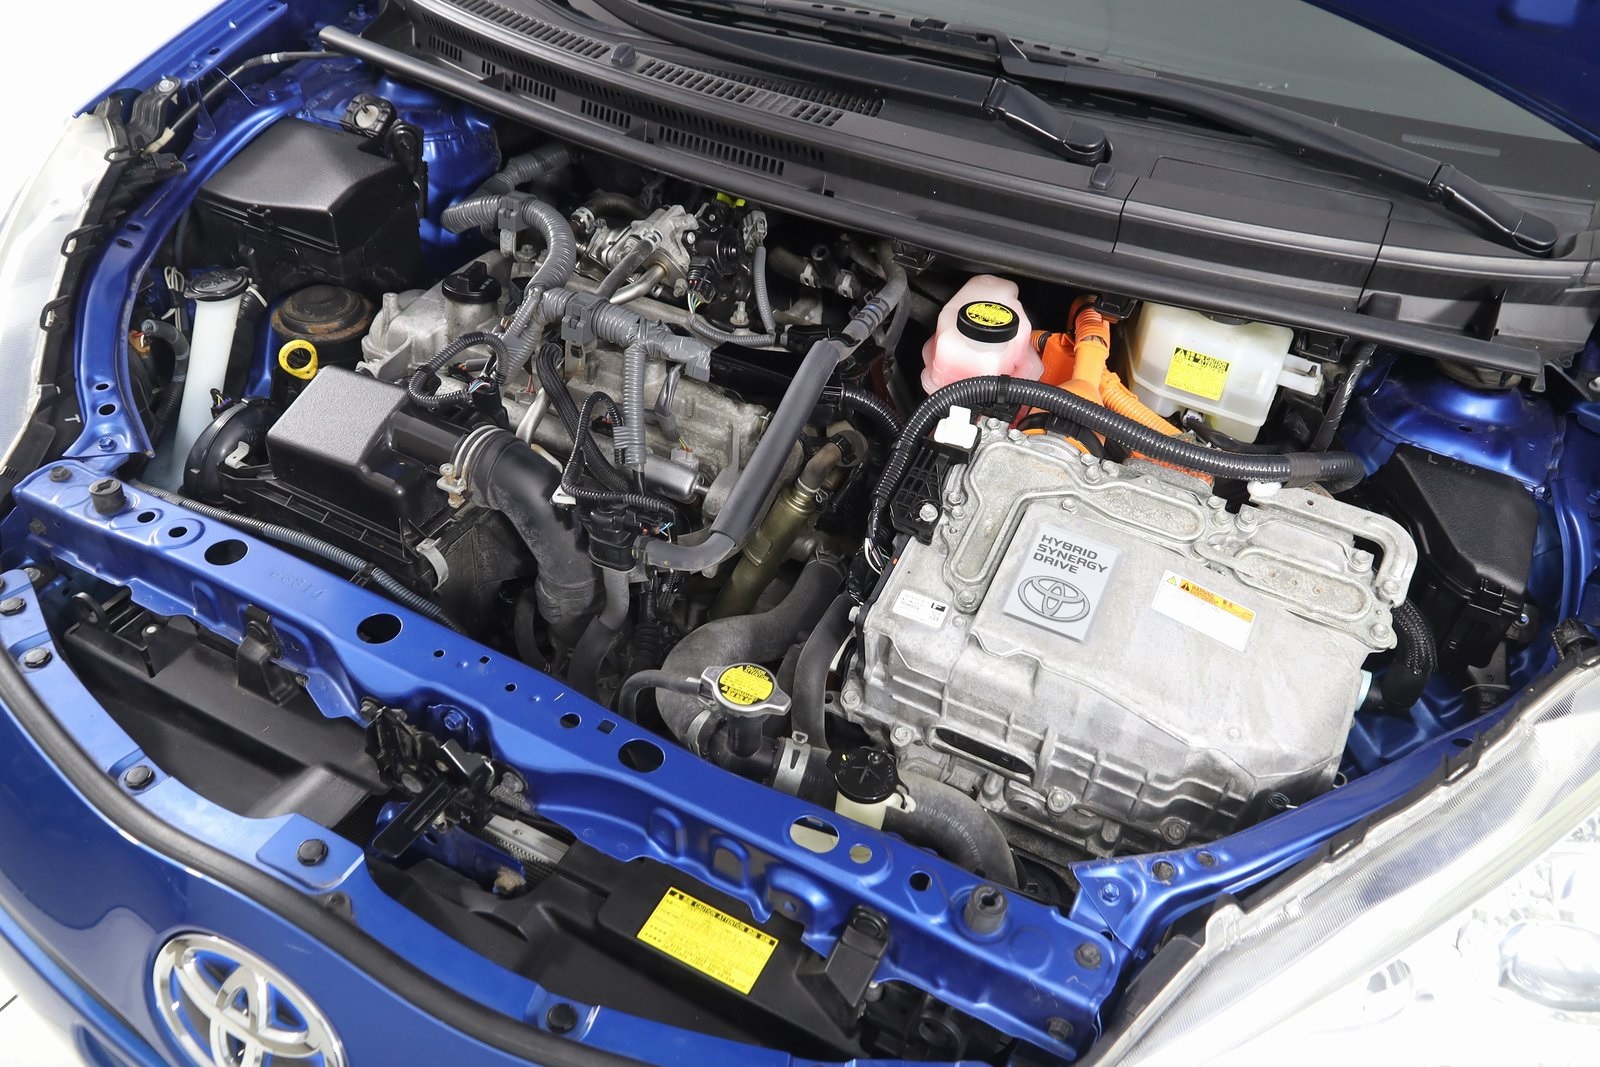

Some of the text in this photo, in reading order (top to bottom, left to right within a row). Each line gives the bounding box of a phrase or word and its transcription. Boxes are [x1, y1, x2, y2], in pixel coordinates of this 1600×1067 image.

[1036, 543, 1108, 573] SYNERGY
[1041, 534, 1098, 560] HYBRID
[1032, 552, 1079, 575] DRIVE
[744, 668, 770, 681] ATTENTION
[746, 664, 767, 675] CAUTION
[695, 902, 746, 932] CAUTION ATTENTION
